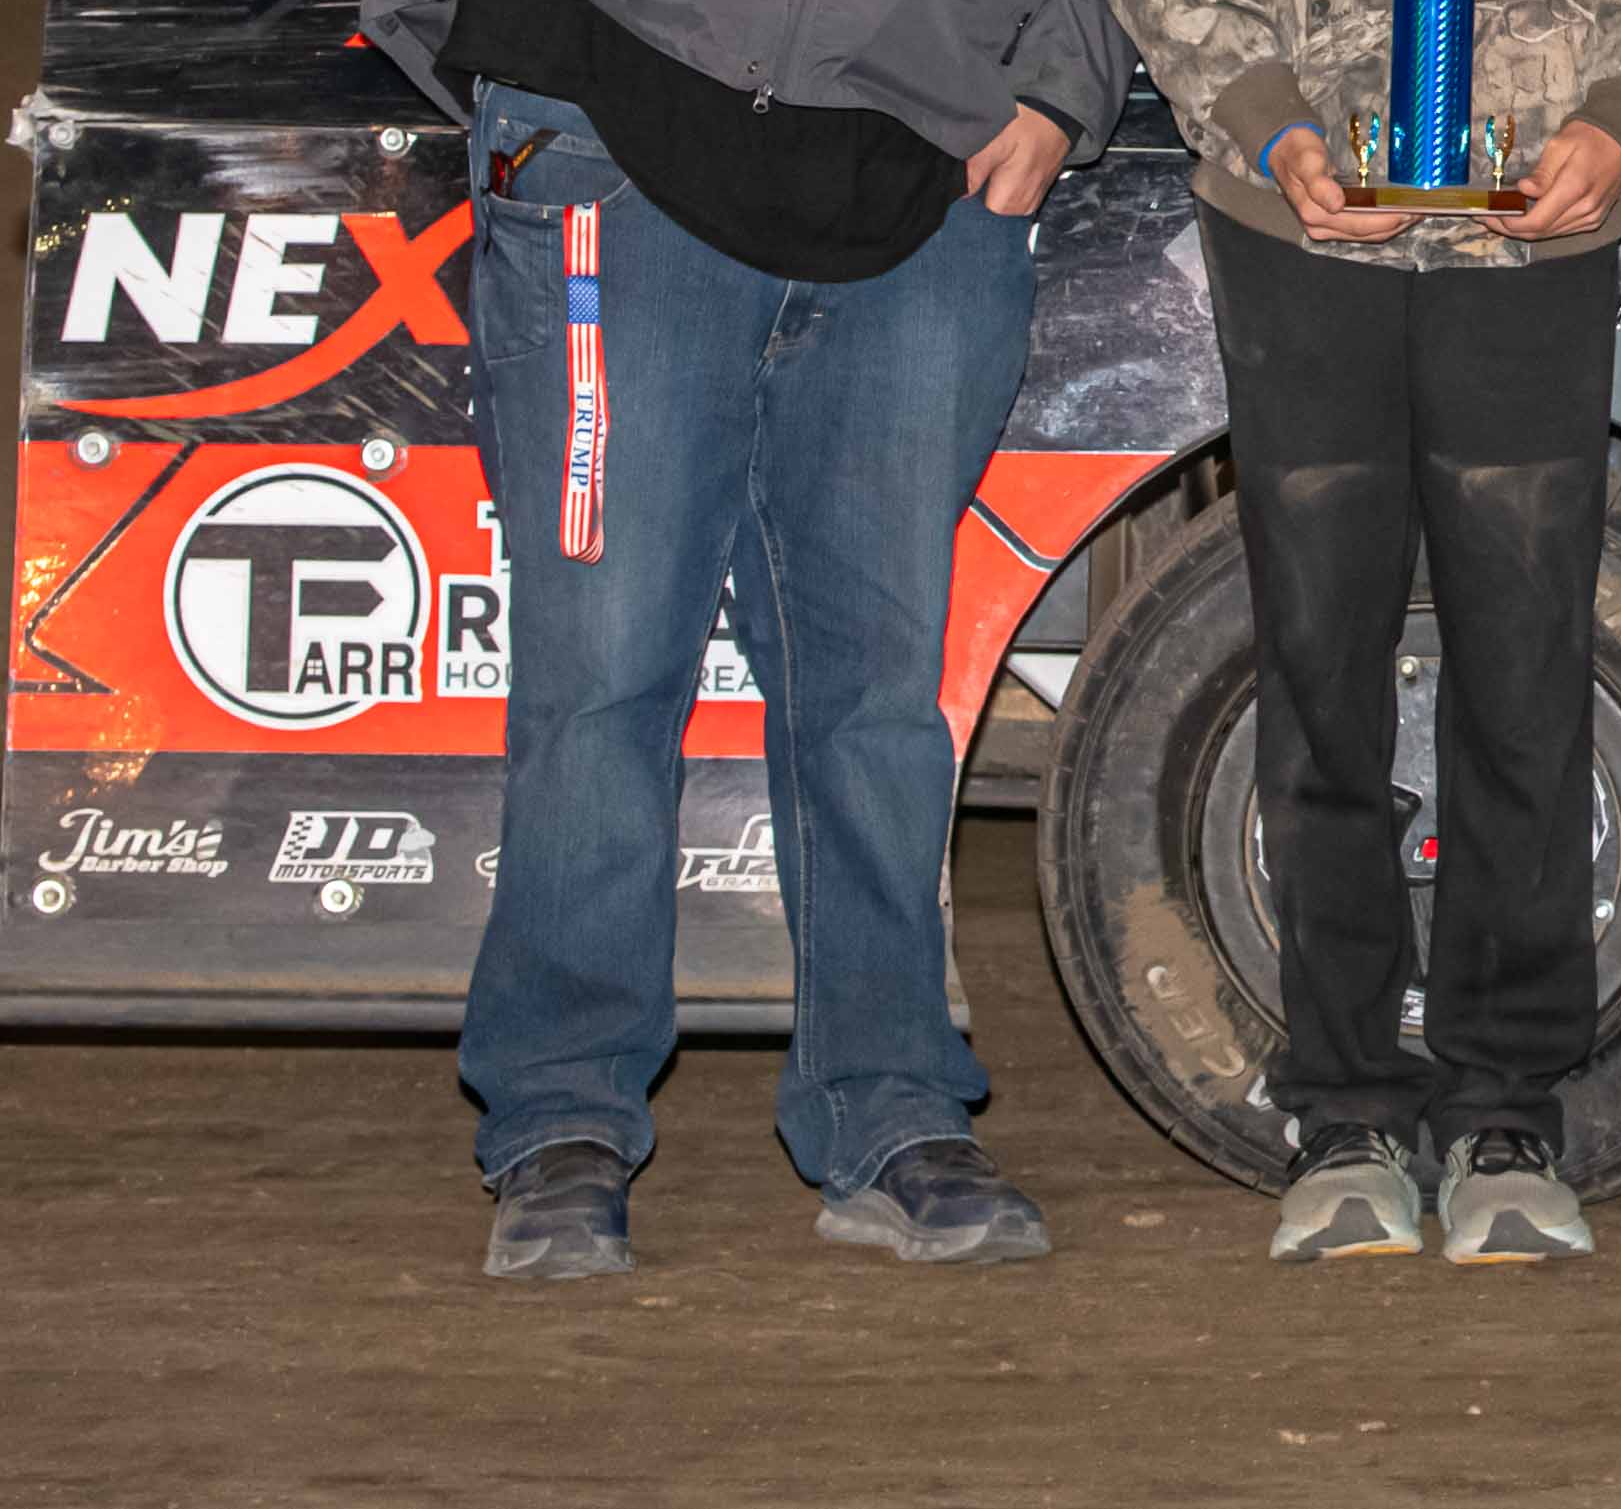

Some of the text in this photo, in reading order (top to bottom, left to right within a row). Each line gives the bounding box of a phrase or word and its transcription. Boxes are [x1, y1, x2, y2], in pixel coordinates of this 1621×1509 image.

[571, 389, 594, 488] TRUMP
[39, 807, 196, 872] Jim's
[79, 855, 229, 879] Barber Shop
[275, 863, 429, 880] MOTORSPORTS
